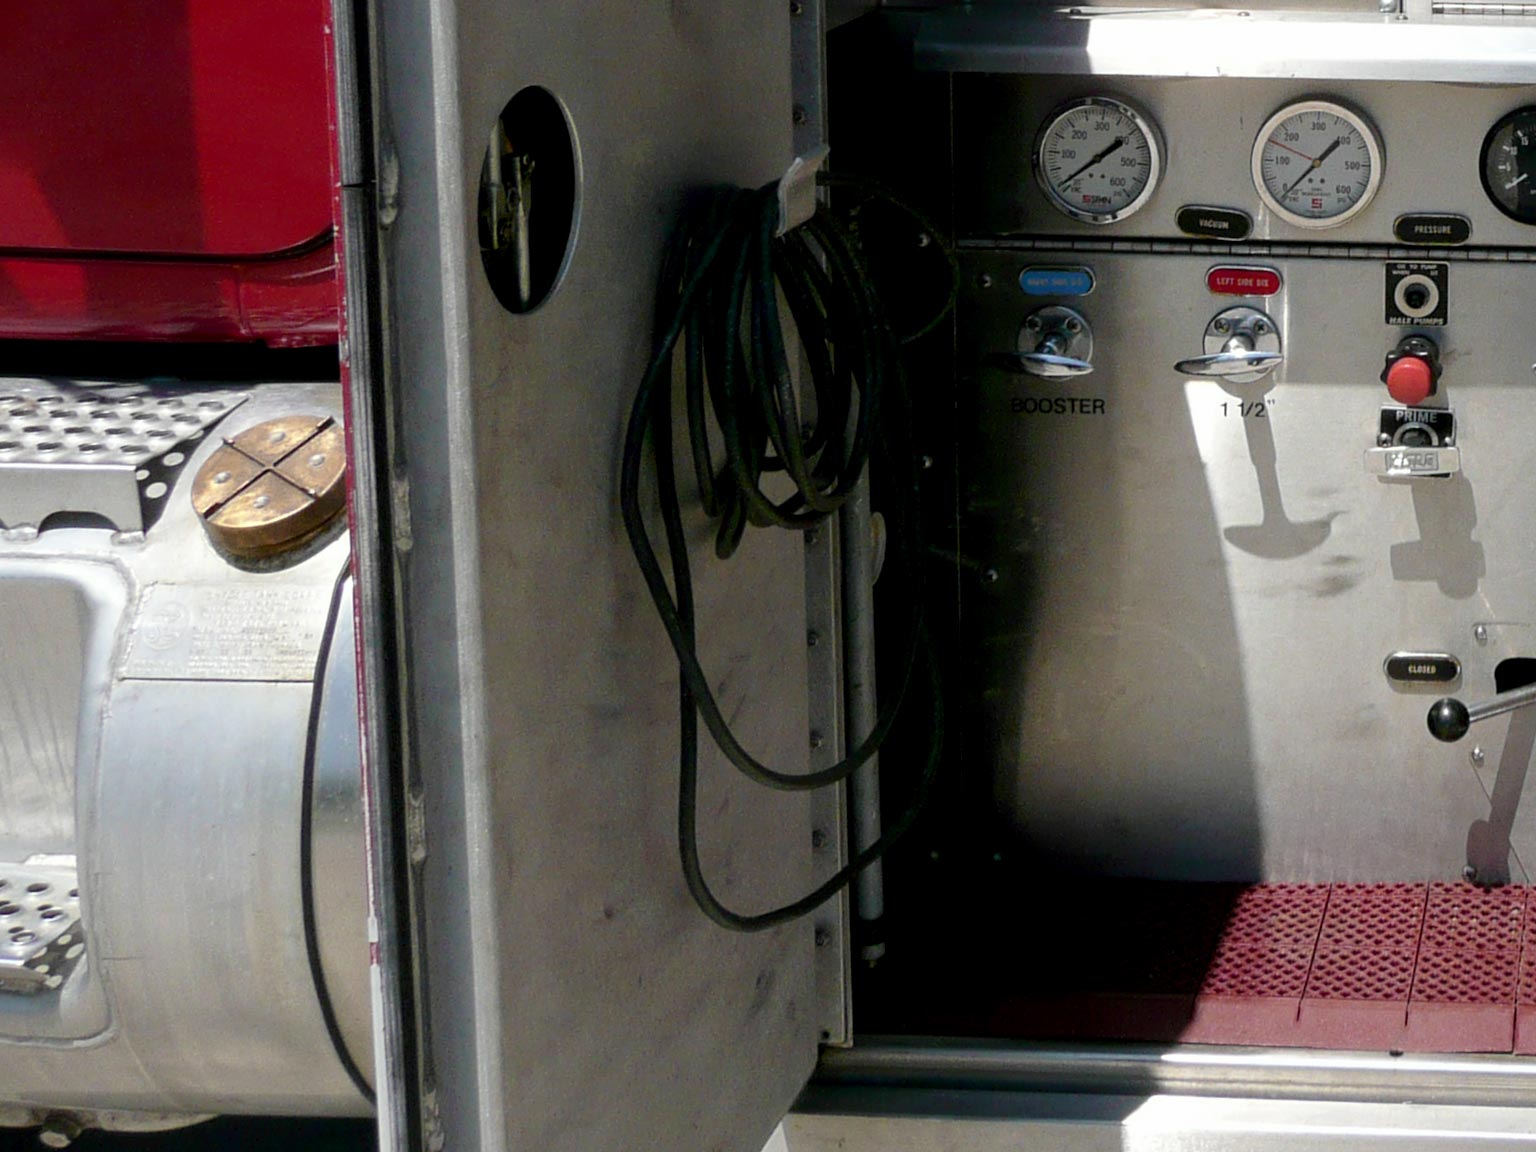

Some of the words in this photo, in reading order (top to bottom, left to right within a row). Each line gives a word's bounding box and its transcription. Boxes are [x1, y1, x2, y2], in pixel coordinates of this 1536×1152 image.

[1094, 121, 1110, 131] 300
[1311, 122, 1326, 131] 300
[1072, 130, 1088, 140] 200
[1284, 132, 1299, 142] 200
[1521, 136, 1529, 146] 15
[1061, 150, 1076, 159] 100
[1510, 146, 1518, 156] 10
[1121, 157, 1137, 167] 500
[1275, 156, 1290, 165] 100
[1344, 161, 1360, 170] 500
[1110, 178, 1126, 187] 600
[1336, 185, 1351, 194] 600
[1199, 218, 1229, 229] VACUUM
[1414, 225, 1452, 234] PRESSURE
[1216, 277, 1235, 286] LEFT
[1237, 278, 1253, 286] SIDE
[1010, 397, 1105, 414] BOOSTER
[1220, 401, 1228, 417] 1
[1395, 410, 1438, 423] PRIME
[1408, 665, 1436, 674] CLOSED
